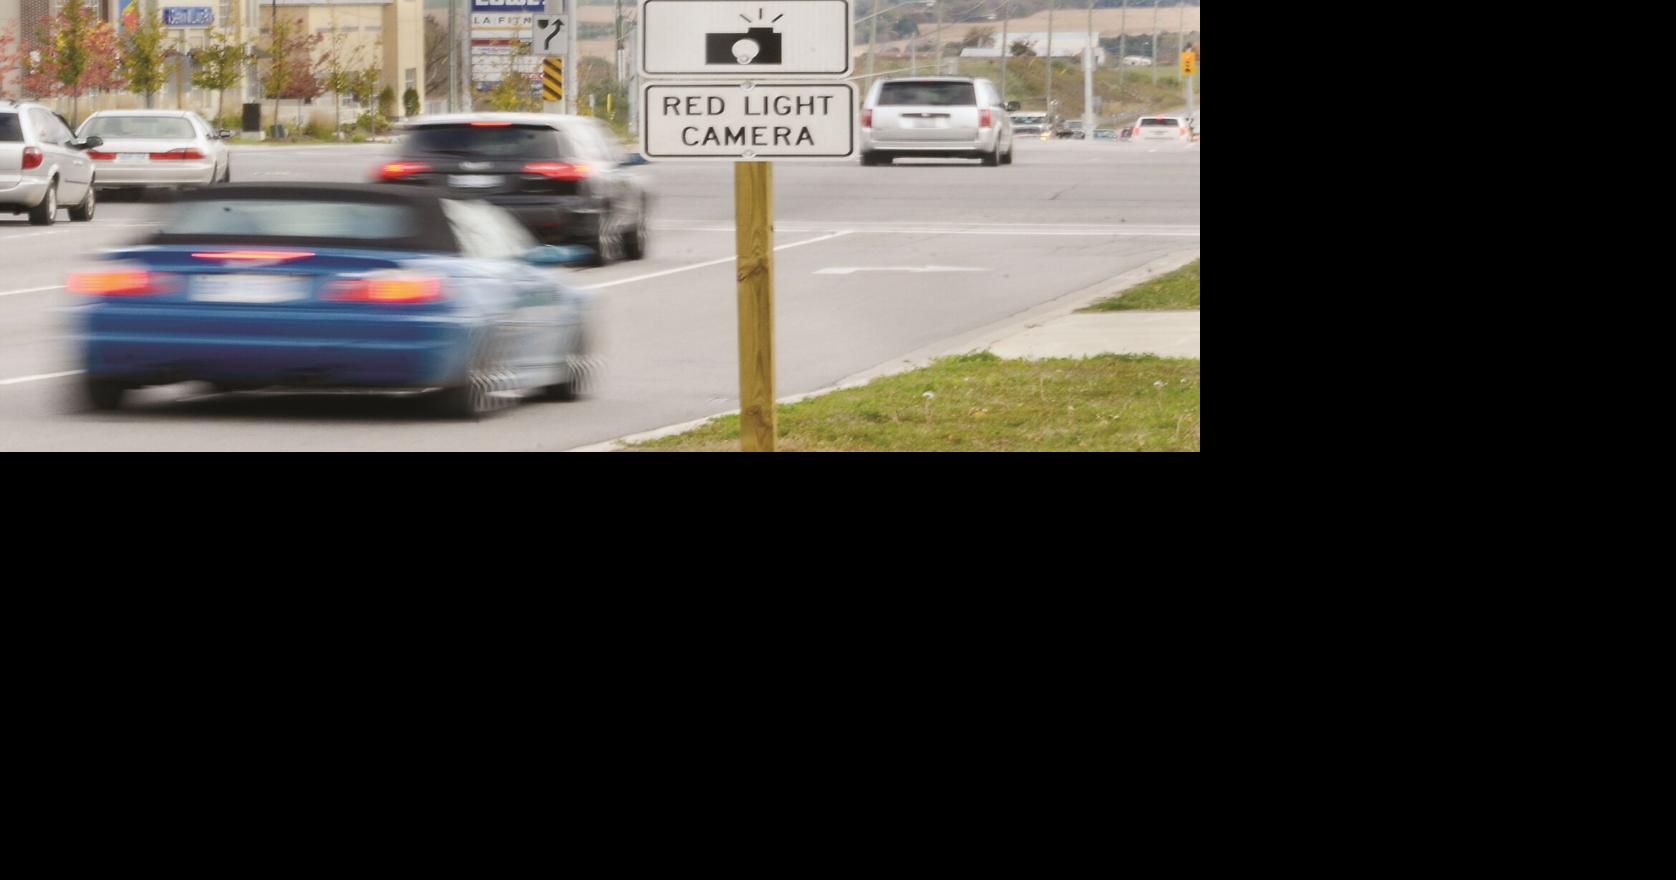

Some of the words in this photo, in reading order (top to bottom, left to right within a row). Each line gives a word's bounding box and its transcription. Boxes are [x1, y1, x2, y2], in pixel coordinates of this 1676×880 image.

[473, 16, 491, 25] LA
[662, 95, 726, 116] RED
[744, 95, 834, 116] LIGHT
[681, 126, 815, 147] CAMERA
